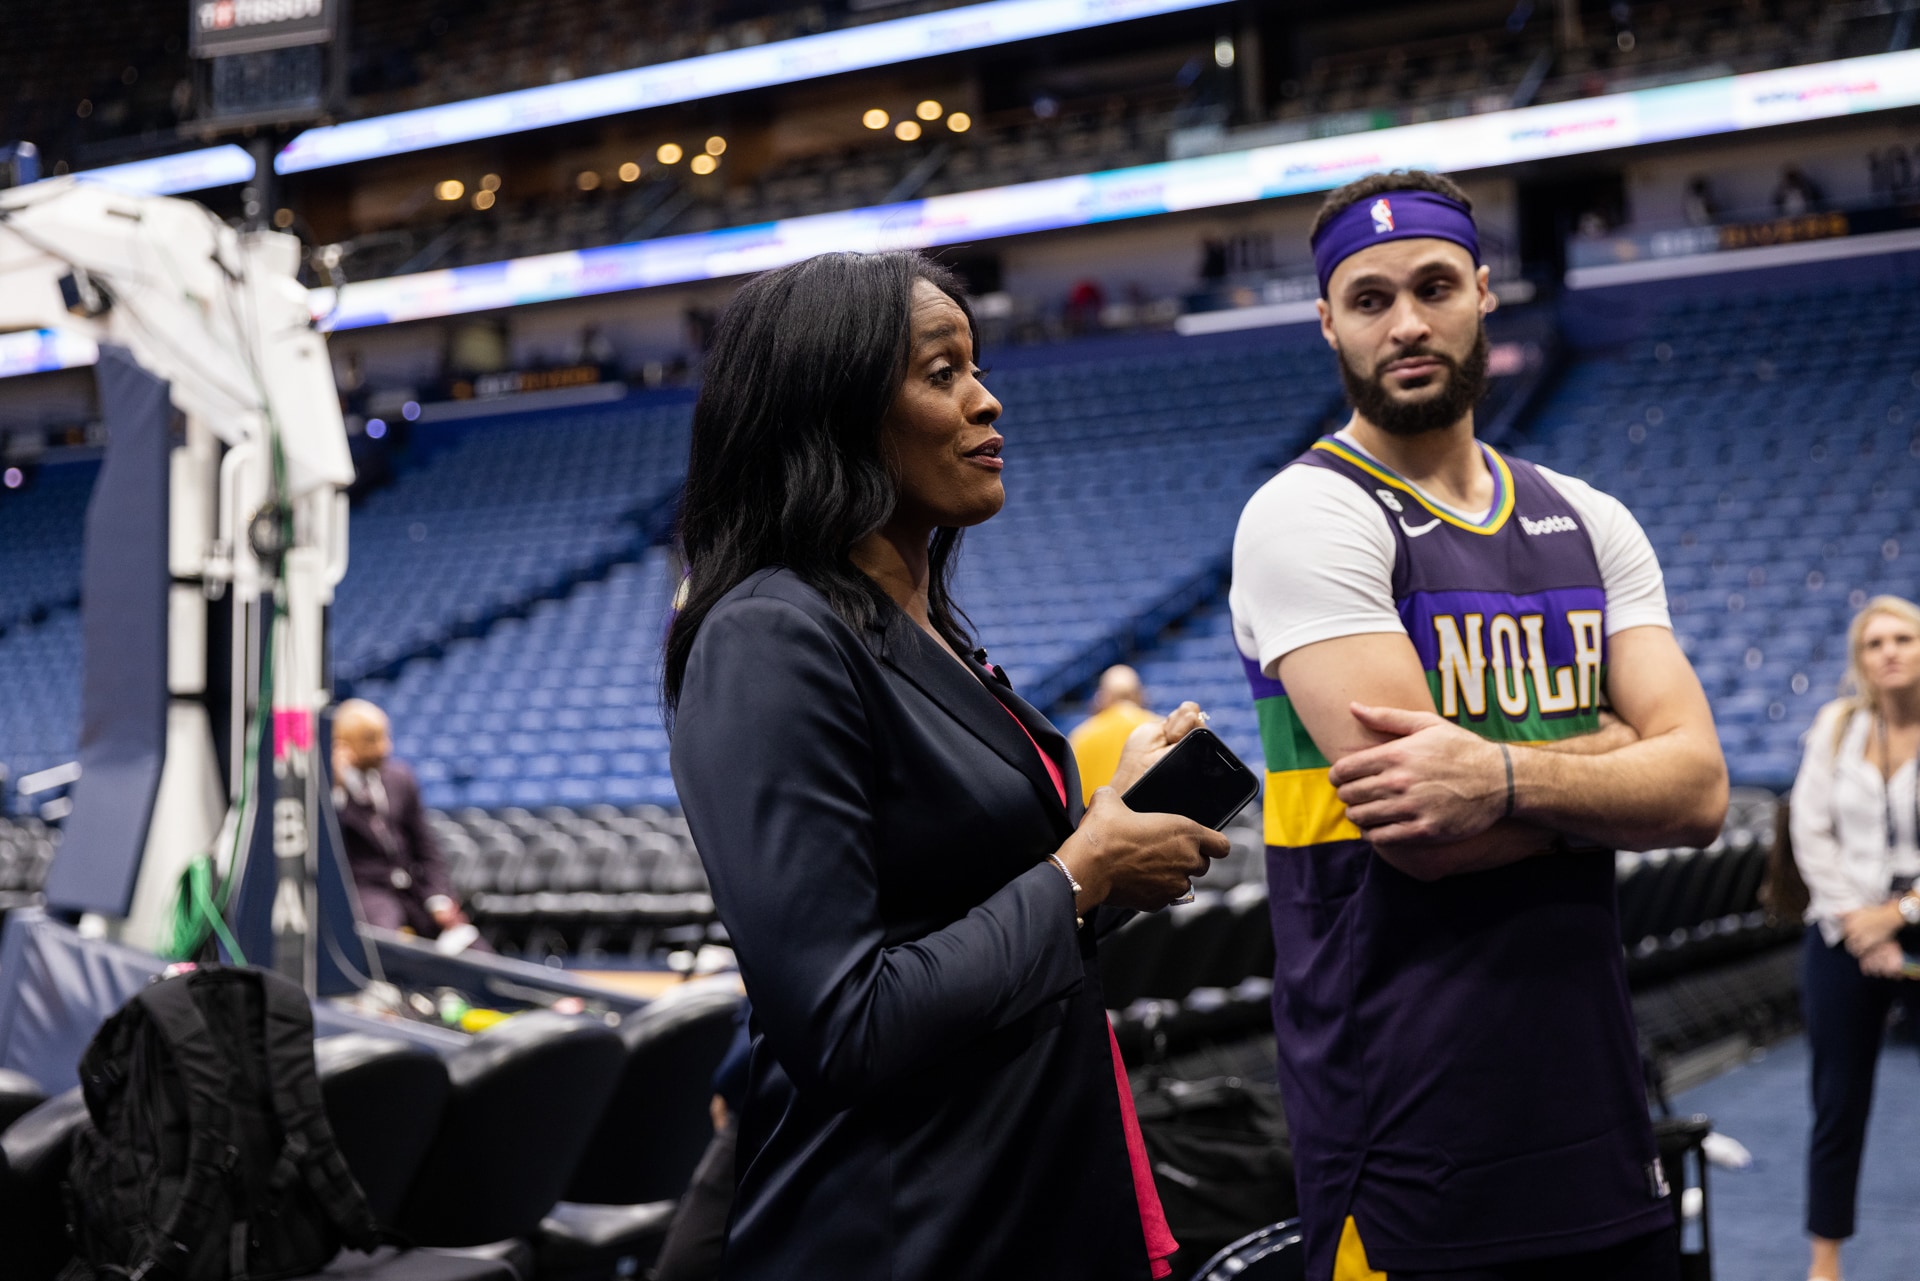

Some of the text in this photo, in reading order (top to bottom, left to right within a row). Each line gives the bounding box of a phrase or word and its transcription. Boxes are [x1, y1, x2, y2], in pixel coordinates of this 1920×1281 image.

[1376, 489, 1403, 512] 6
[1519, 515, 1578, 535] ibotta
[1432, 609, 1603, 720] NOLA
